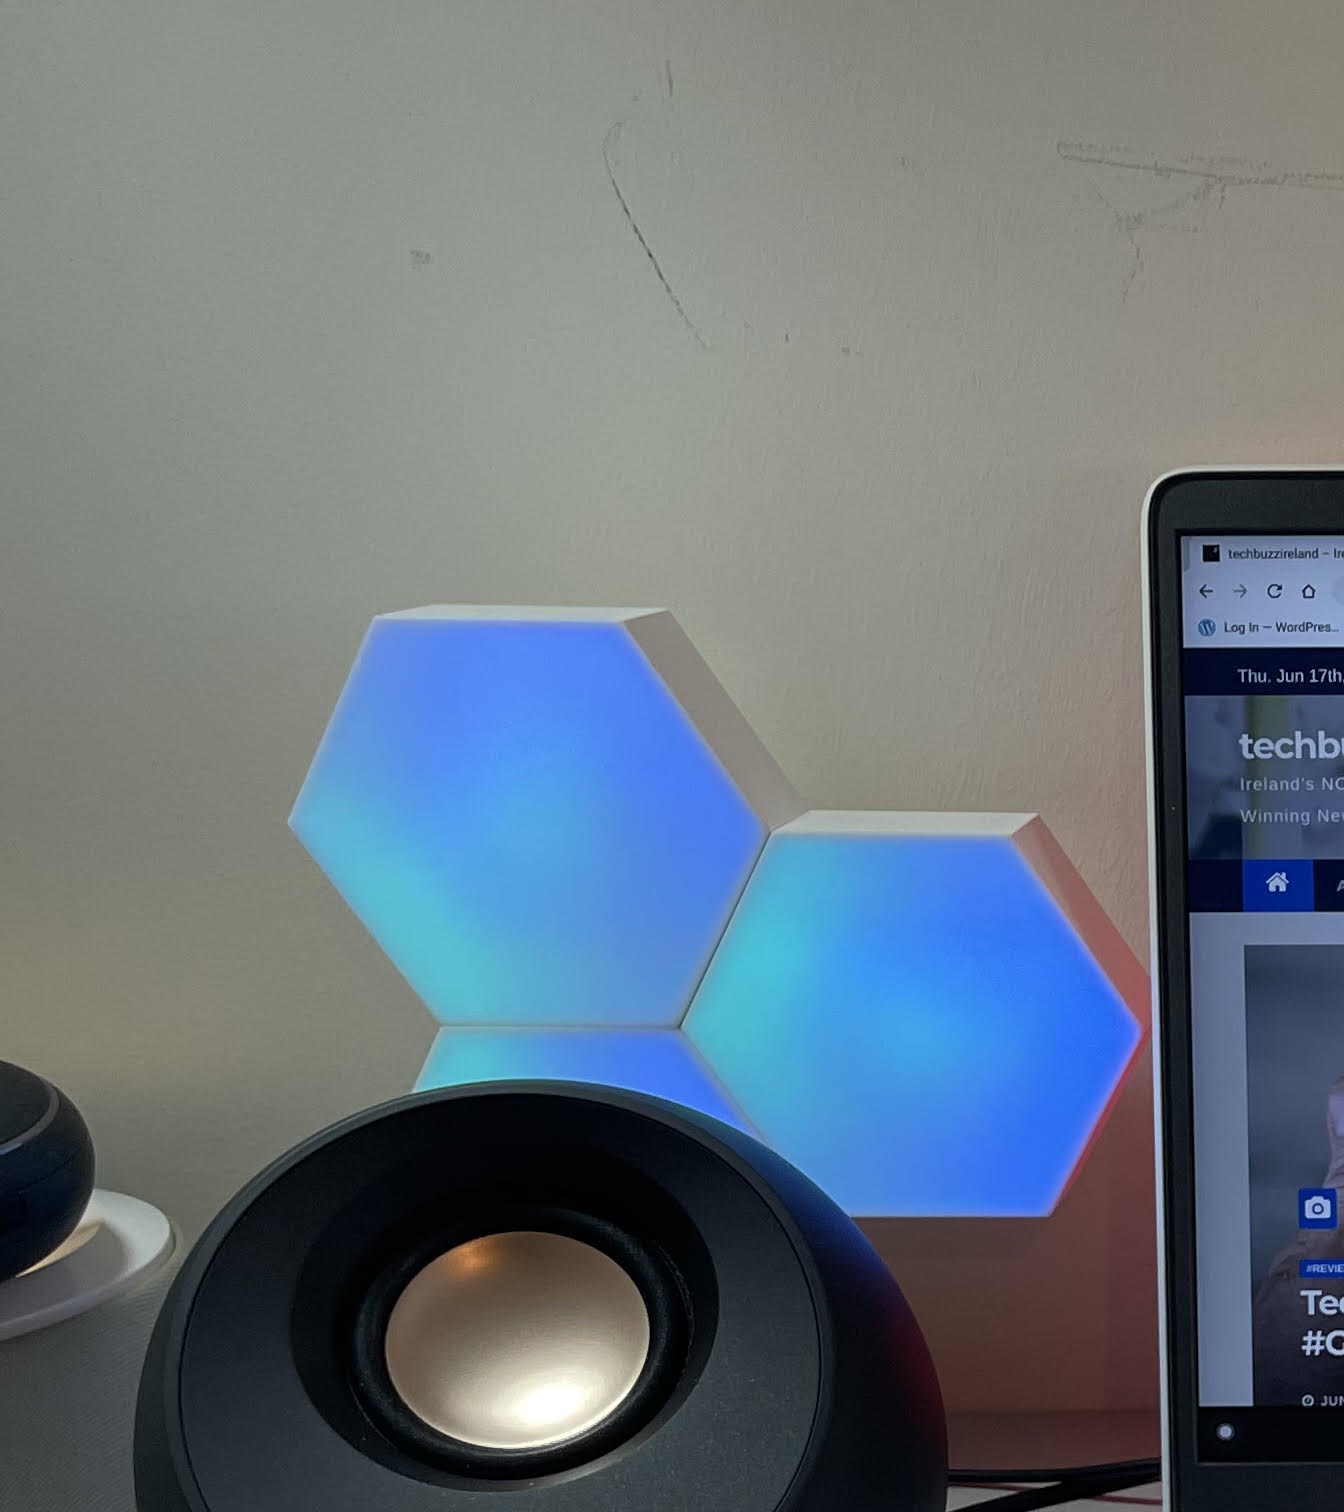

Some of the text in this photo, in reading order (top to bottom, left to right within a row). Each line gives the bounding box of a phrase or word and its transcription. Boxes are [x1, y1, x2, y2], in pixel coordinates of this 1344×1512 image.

[1228, 548, 1319, 559] techbuzzireland
[1224, 622, 1259, 634] Log In
[1237, 669, 1271, 683] Thu.
[1276, 669, 1304, 683] Jun
[1240, 776, 1314, 792] Ireland's
[1240, 808, 1311, 826] Winning
